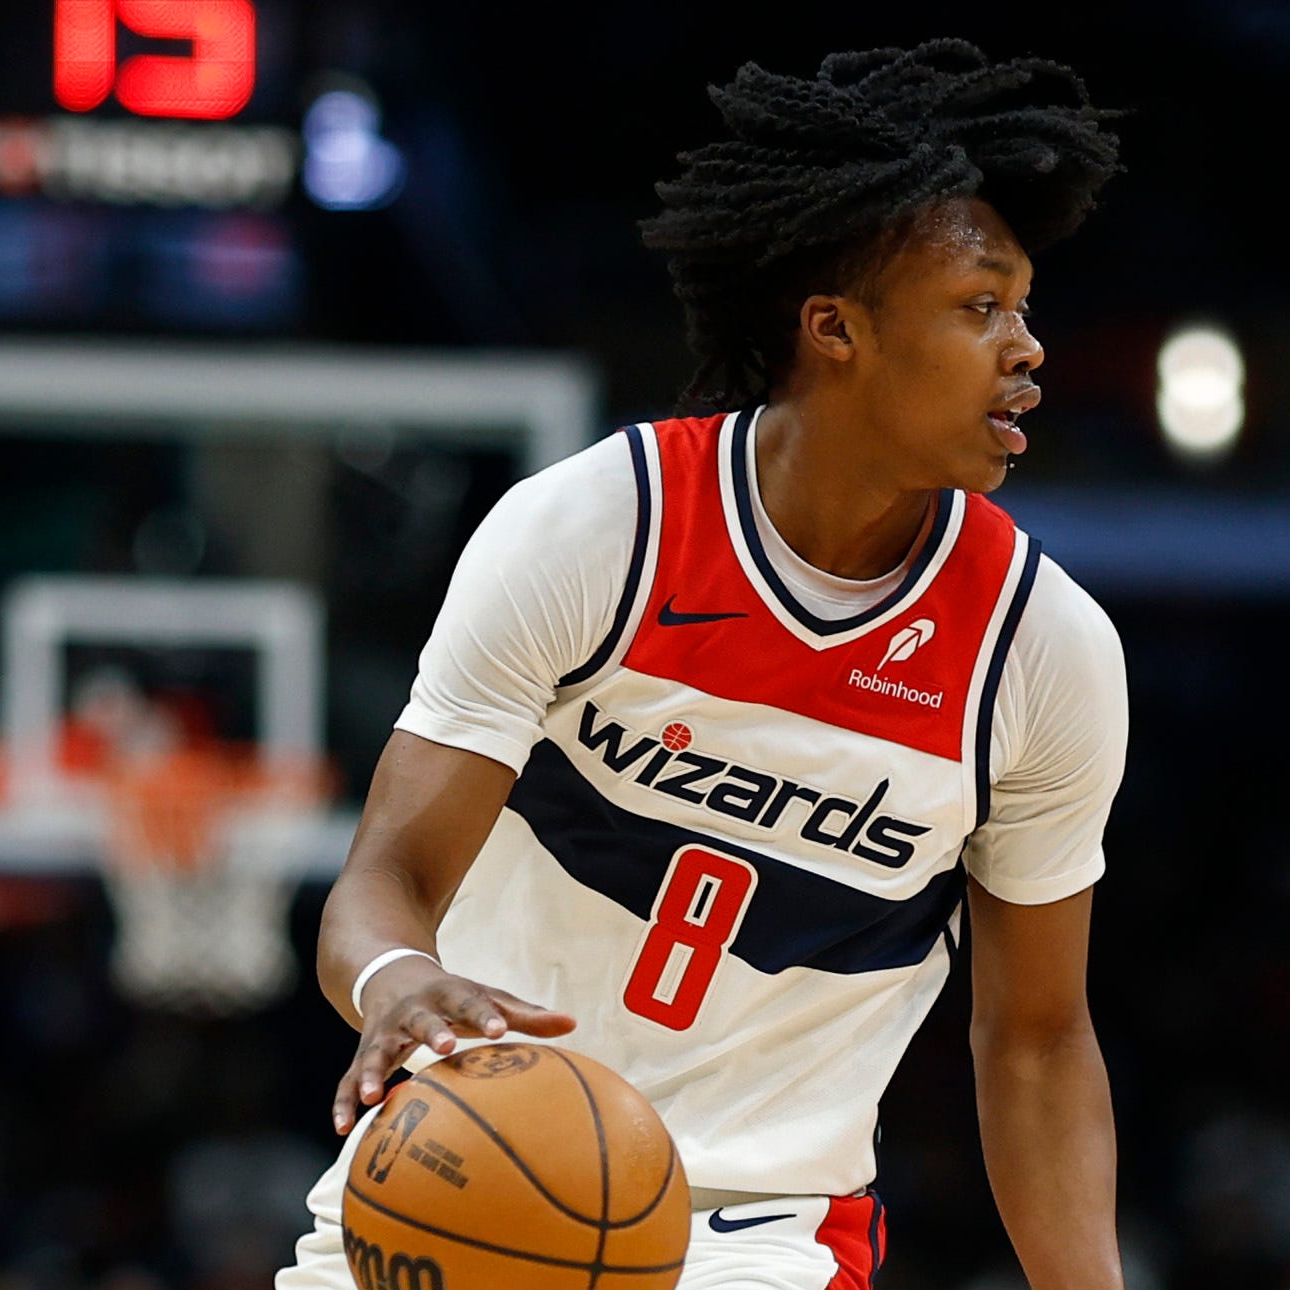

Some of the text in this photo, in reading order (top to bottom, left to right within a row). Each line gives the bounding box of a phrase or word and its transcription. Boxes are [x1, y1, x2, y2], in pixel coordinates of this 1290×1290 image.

[848, 669, 944, 709] Robinhood
[577, 700, 933, 869] wizards
[621, 846, 755, 1033] 8
